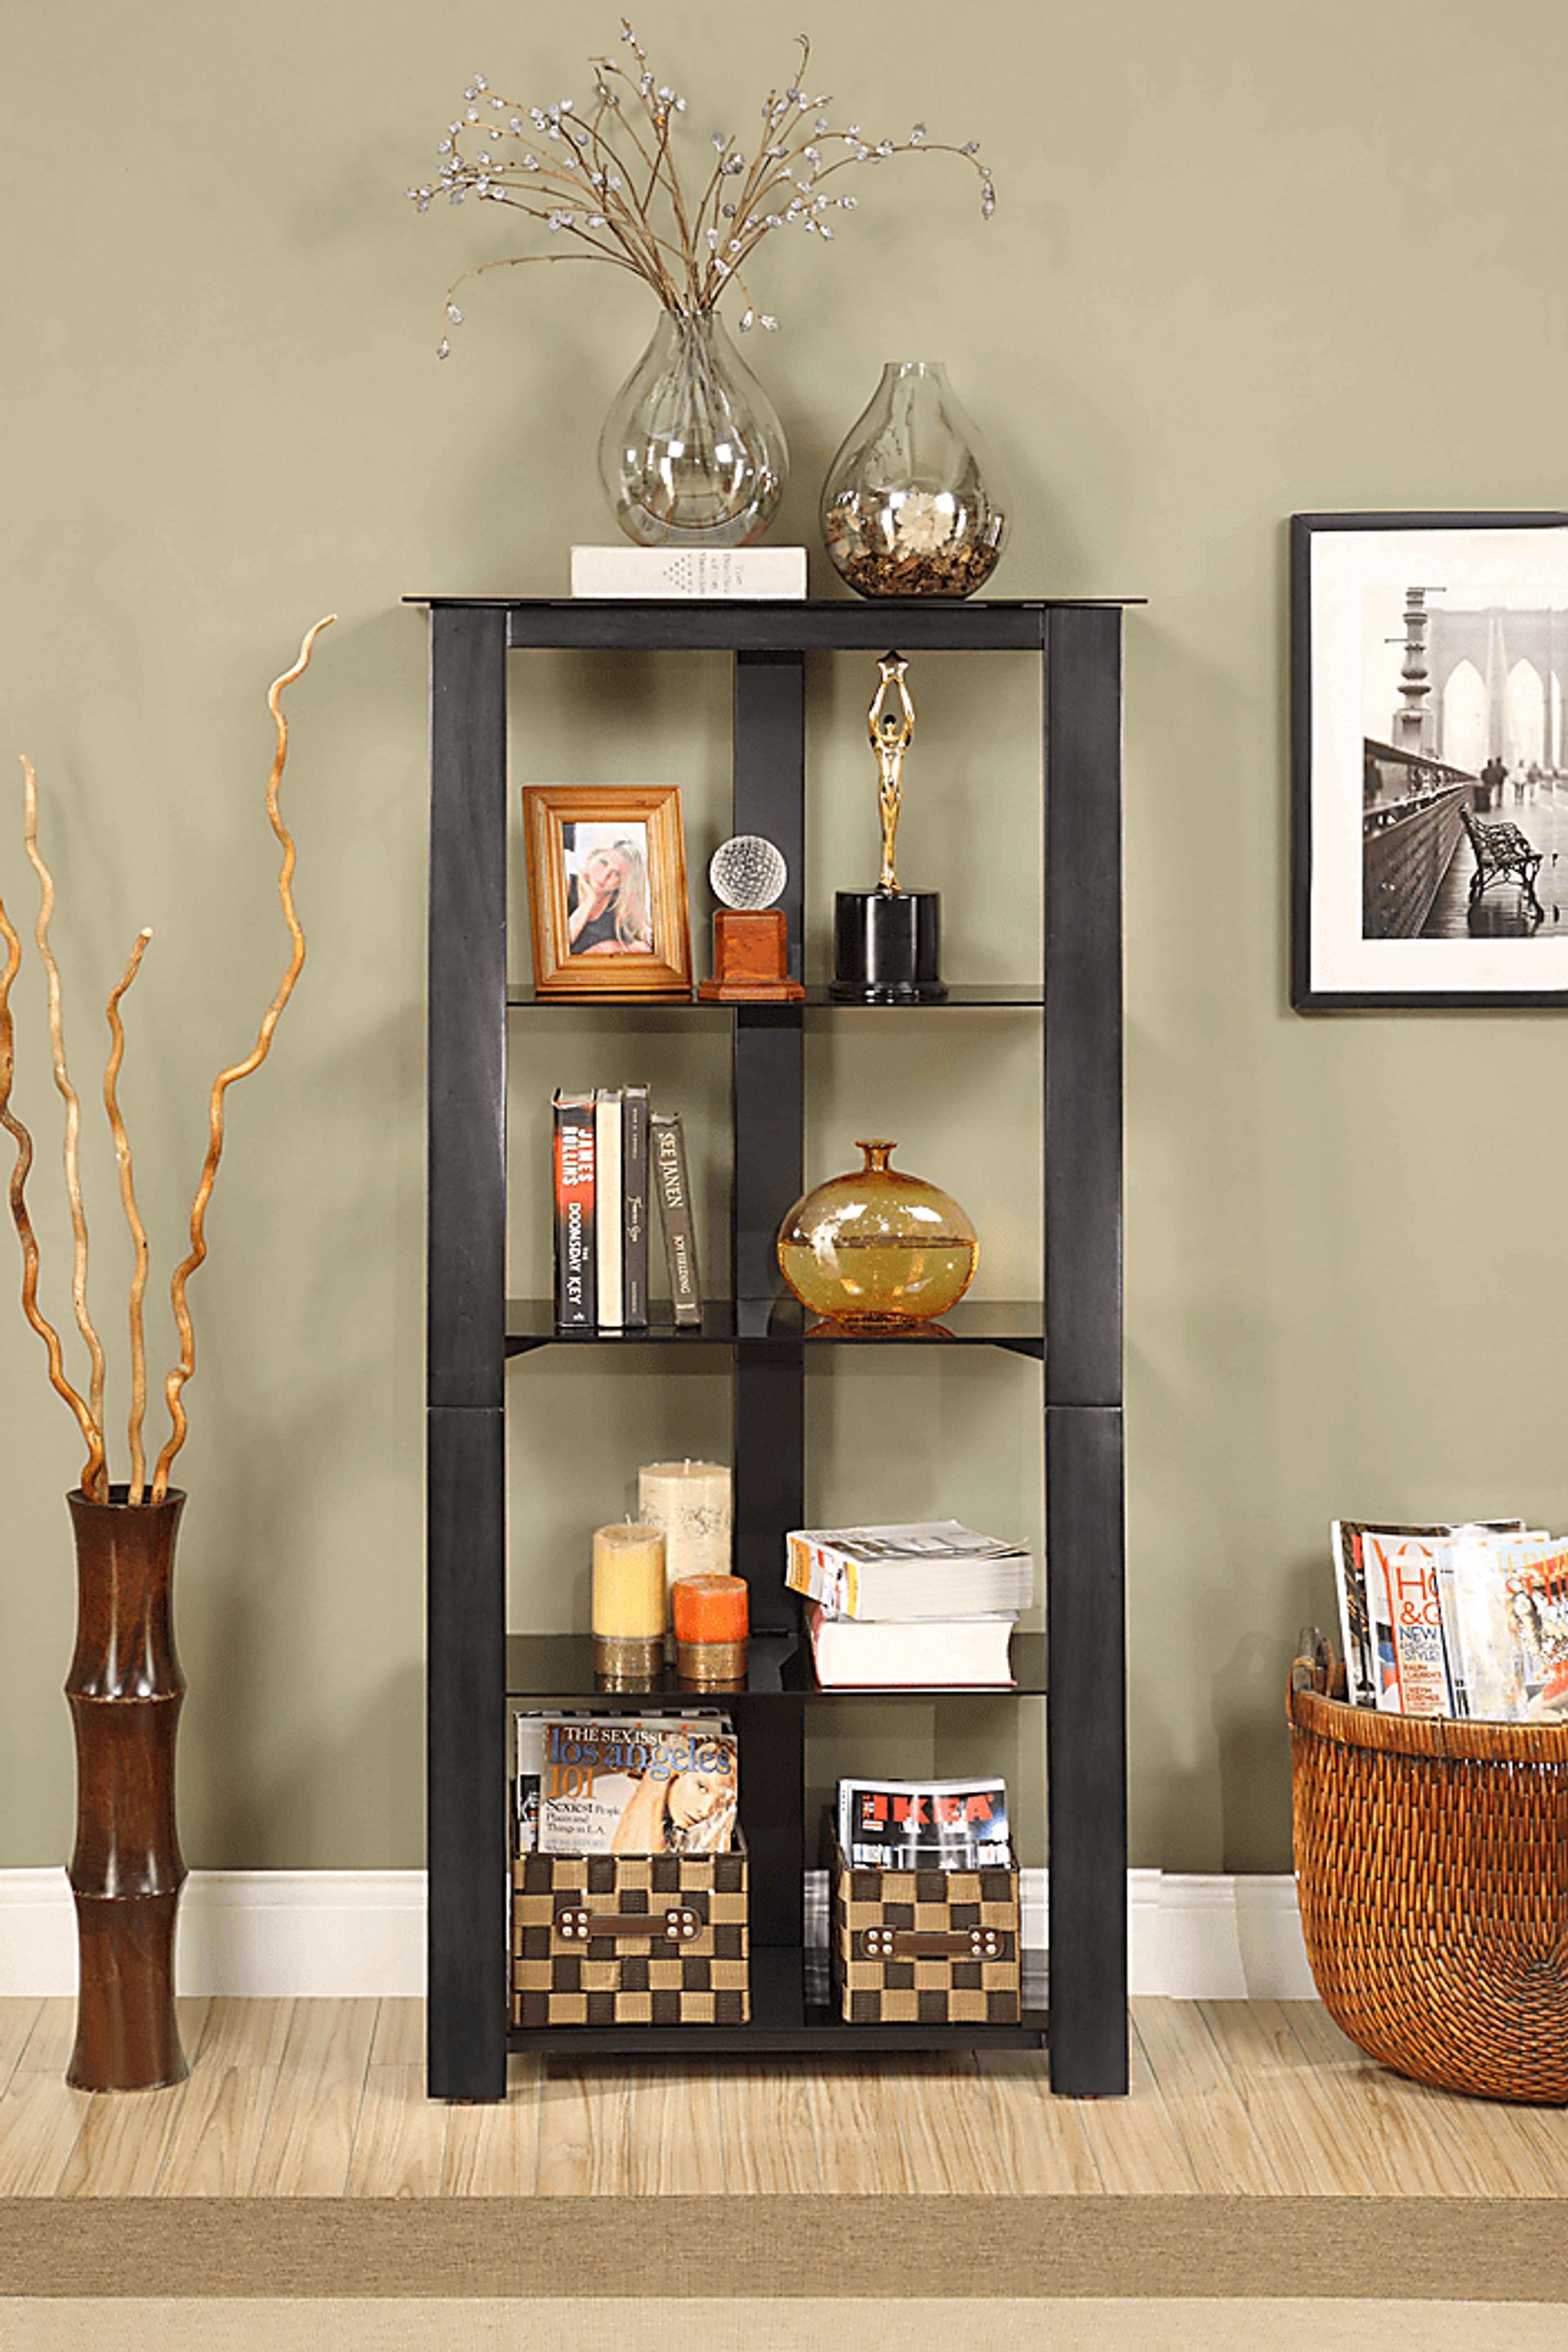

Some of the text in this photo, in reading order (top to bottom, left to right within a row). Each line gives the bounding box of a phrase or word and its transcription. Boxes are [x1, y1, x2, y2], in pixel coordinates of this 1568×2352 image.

[562, 1126, 579, 1186] ROLLINS
[578, 1129, 594, 1183] JAMES
[567, 1202, 581, 1304] DOOMSDAY KEY
[1400, 1626, 1437, 1641] NEW
[547, 1726, 732, 1781] los angeles
[565, 1726, 599, 1742] THE
[601, 1728, 633, 1744] SEX
[548, 1765, 595, 1799] 101
[862, 1793, 993, 1824] IKEA
